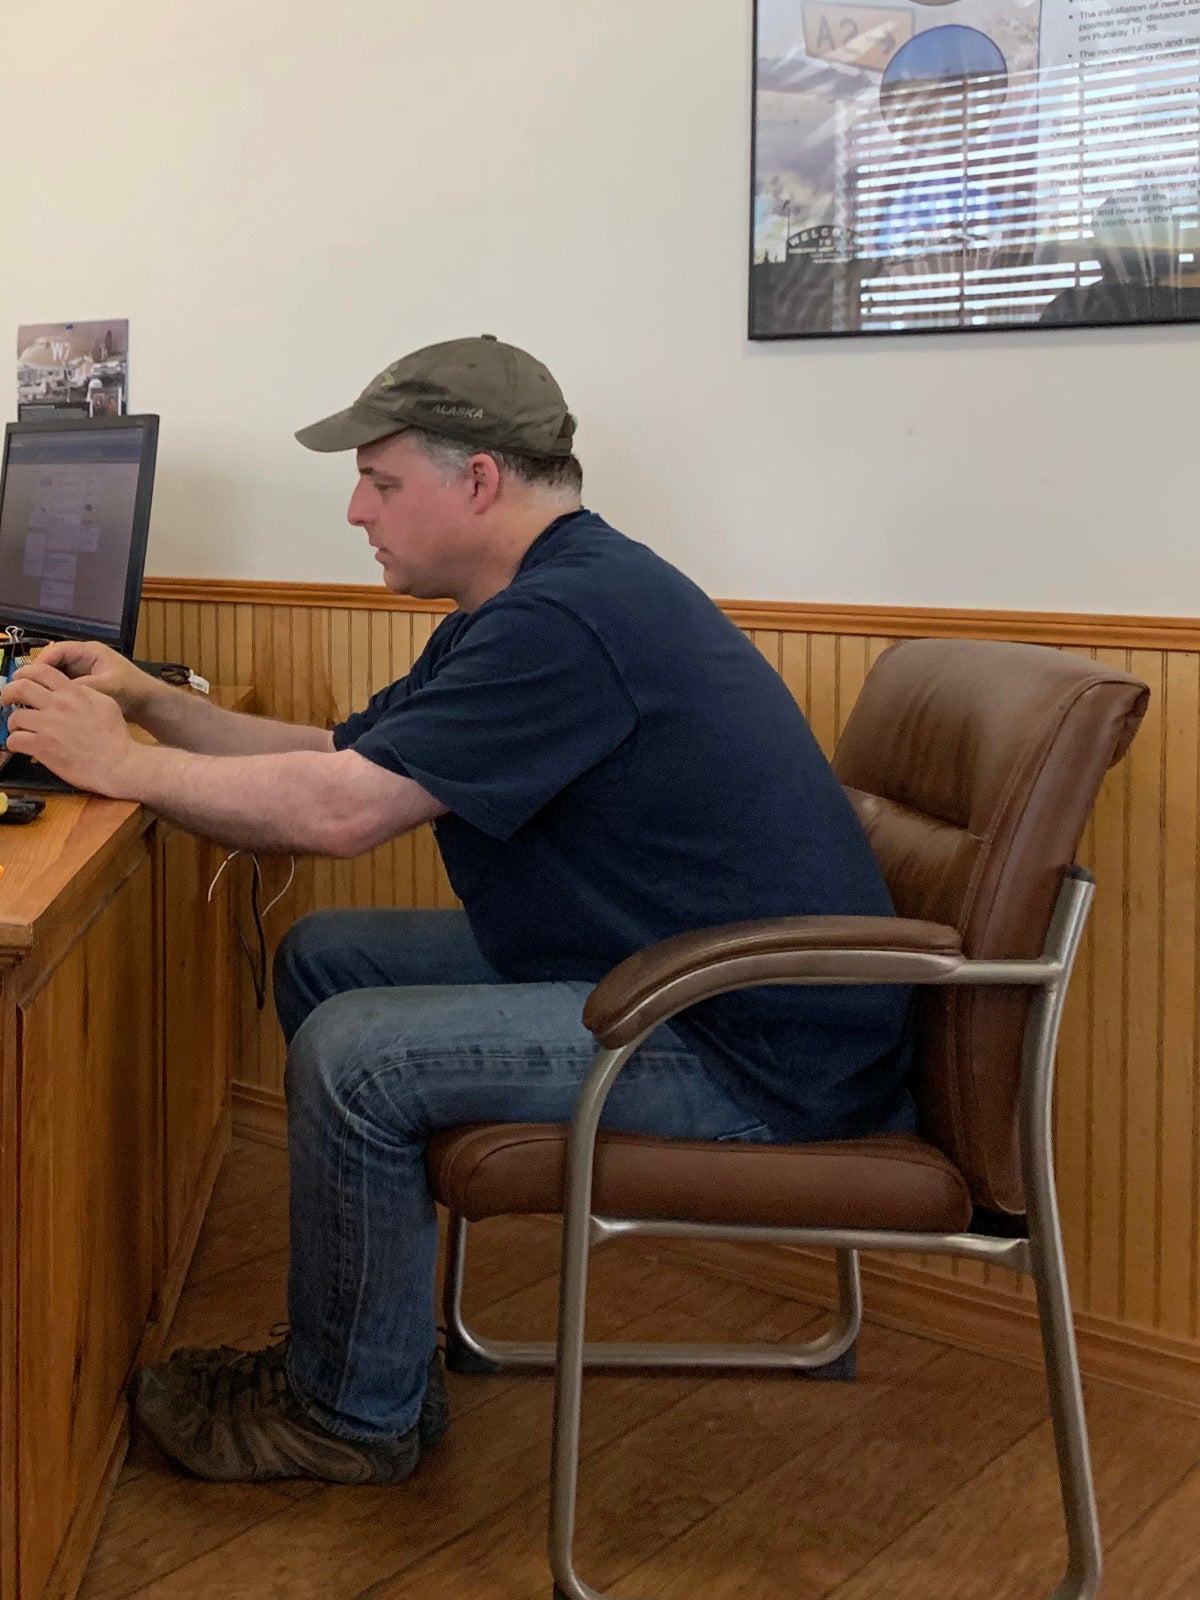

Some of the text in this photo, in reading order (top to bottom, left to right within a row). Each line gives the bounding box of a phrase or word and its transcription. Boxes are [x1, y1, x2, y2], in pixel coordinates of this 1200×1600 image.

[1098, 5, 1147, 17] installation
[1079, 20, 1114, 32] position
[1145, 11, 1186, 21] distance
[1092, 30, 1128, 40] Runway
[1097, 42, 1162, 56] reconstruction
